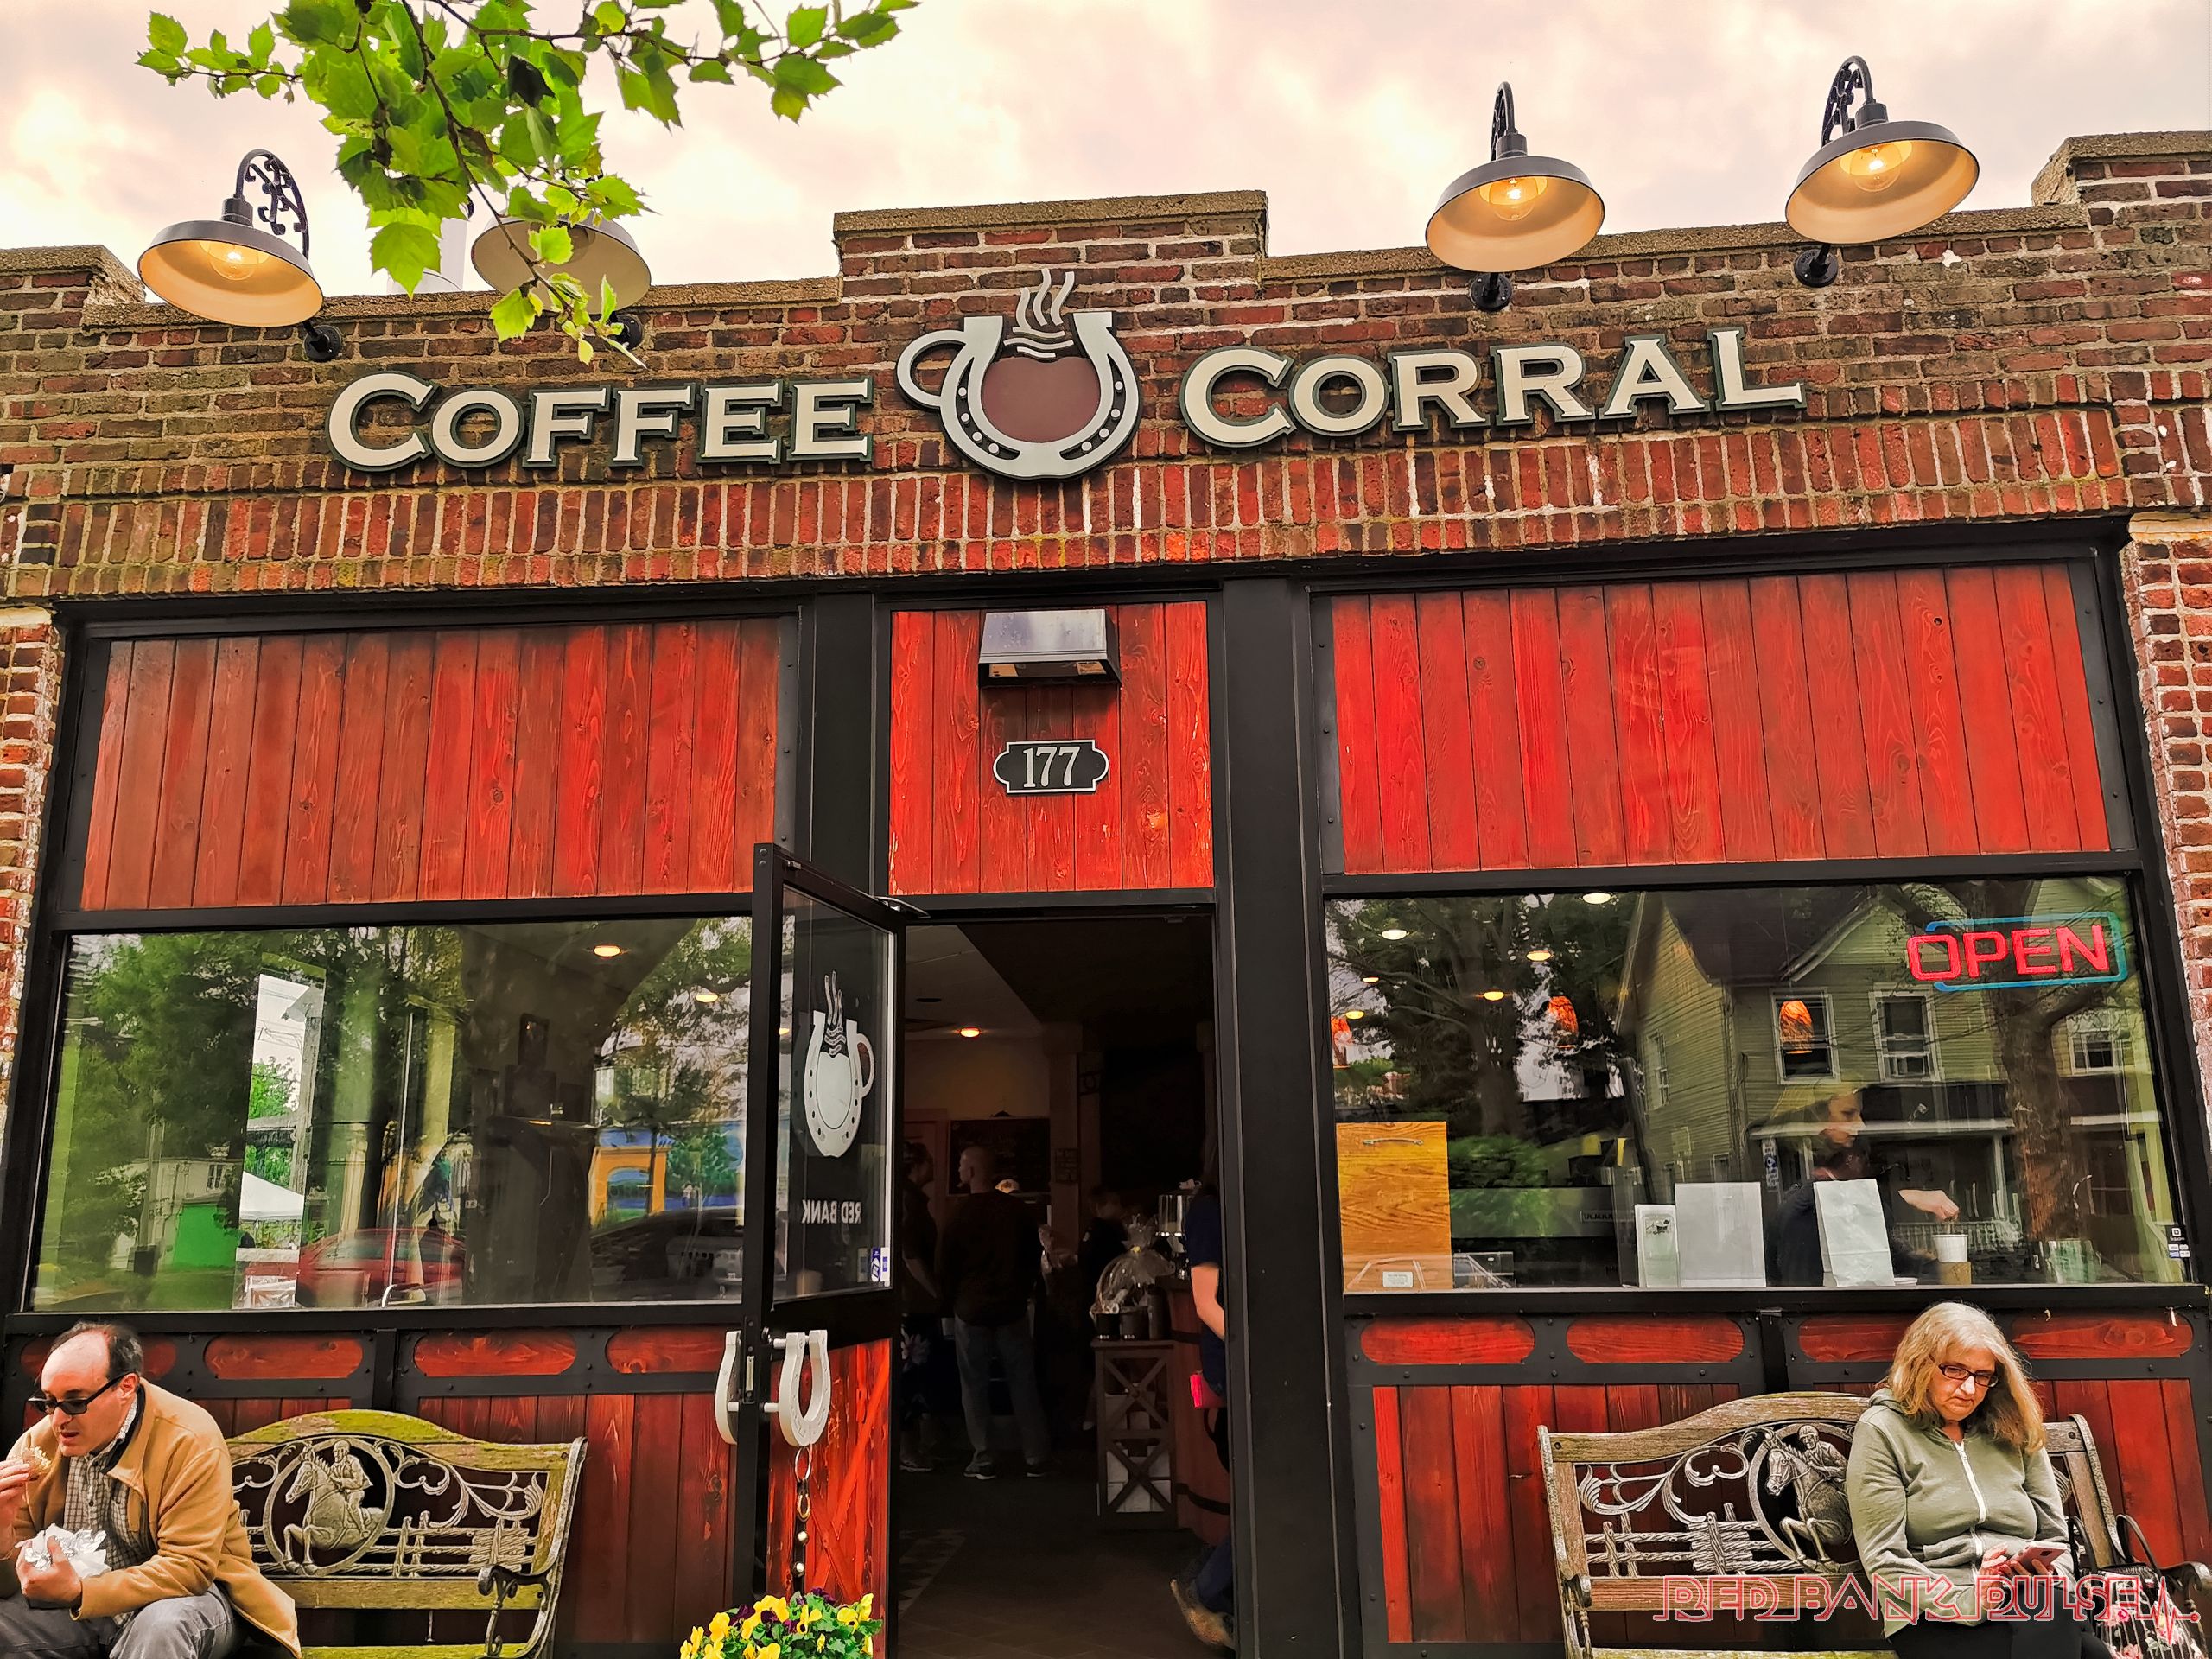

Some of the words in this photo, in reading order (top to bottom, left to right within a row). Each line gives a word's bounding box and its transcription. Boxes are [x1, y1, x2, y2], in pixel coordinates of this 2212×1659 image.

[326, 371, 873, 473] COFFEE
[1180, 327, 1806, 448] CORRAL
[1023, 746, 1080, 787] 177
[1906, 924, 2109, 981] OPEN
